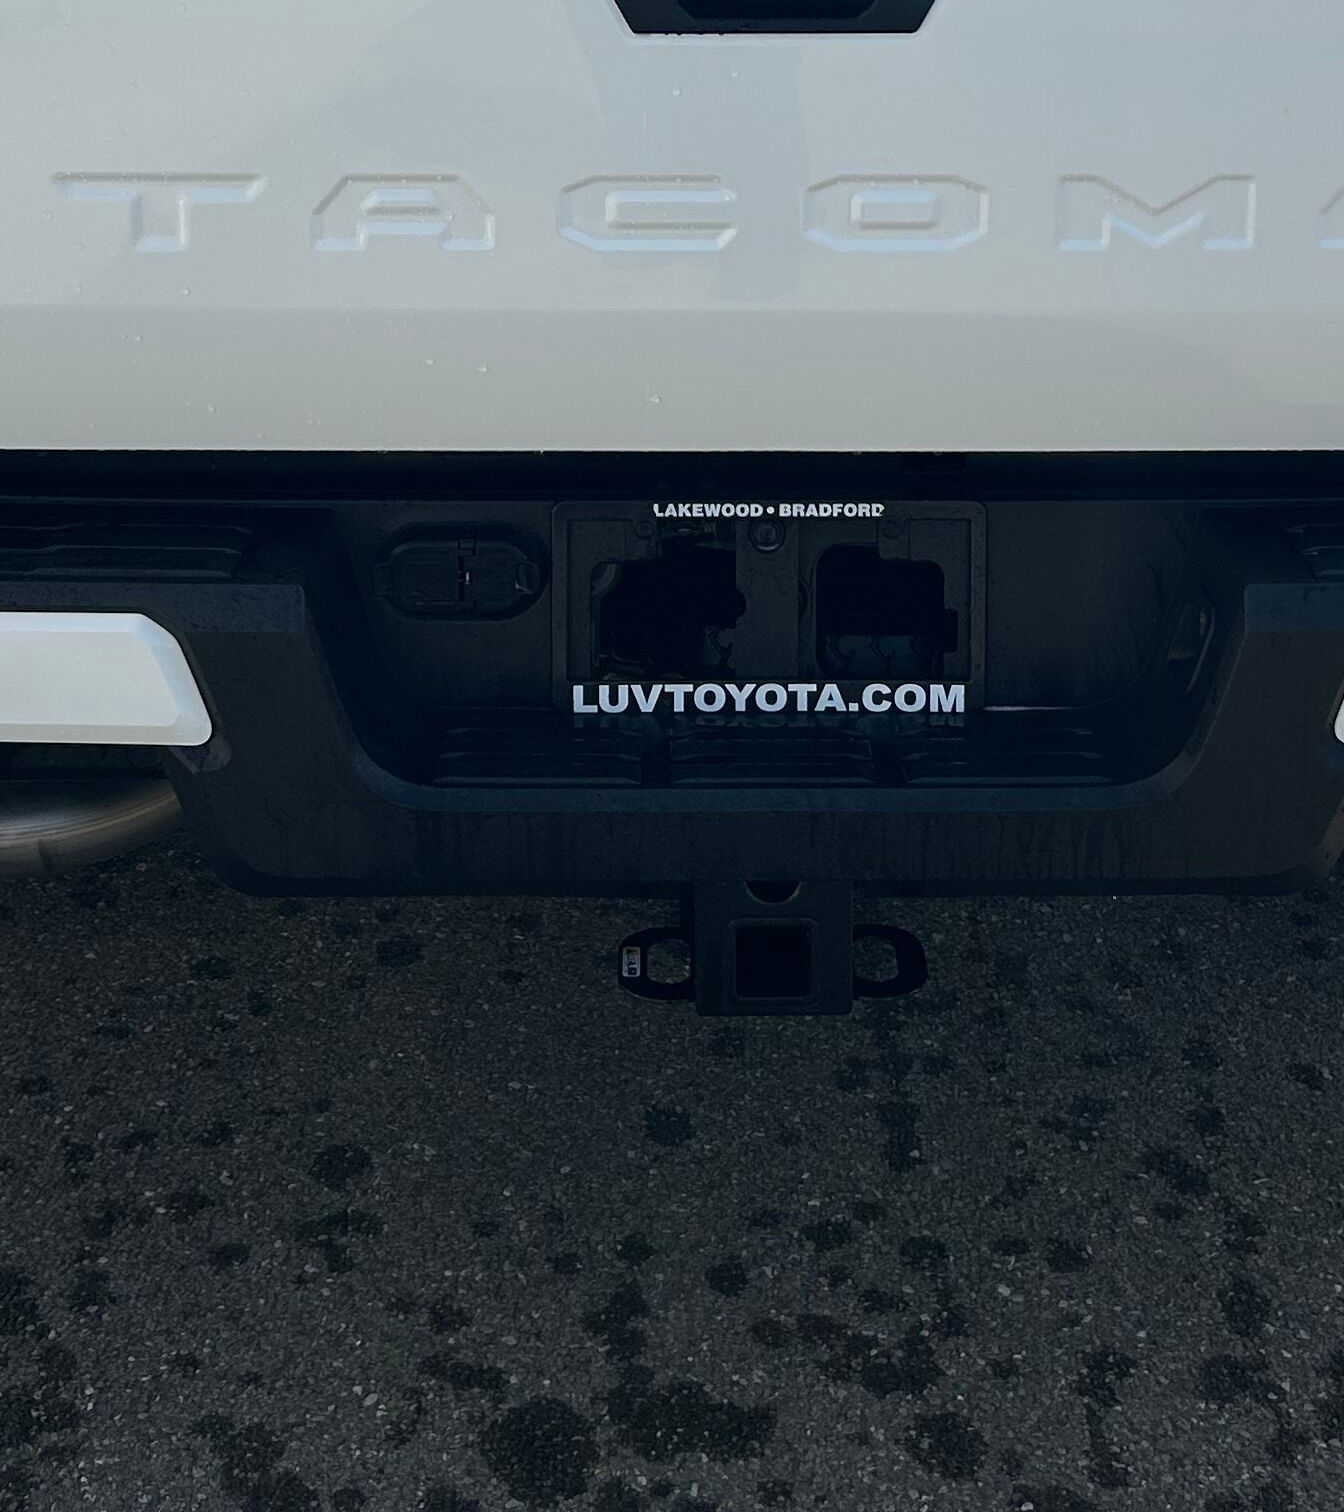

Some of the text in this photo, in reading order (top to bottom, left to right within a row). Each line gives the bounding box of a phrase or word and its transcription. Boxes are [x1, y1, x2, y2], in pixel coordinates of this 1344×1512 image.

[653, 503, 885, 517] LAKEWOOD BRADFORD
[572, 683, 966, 713] LUVTOYOTA.COM
